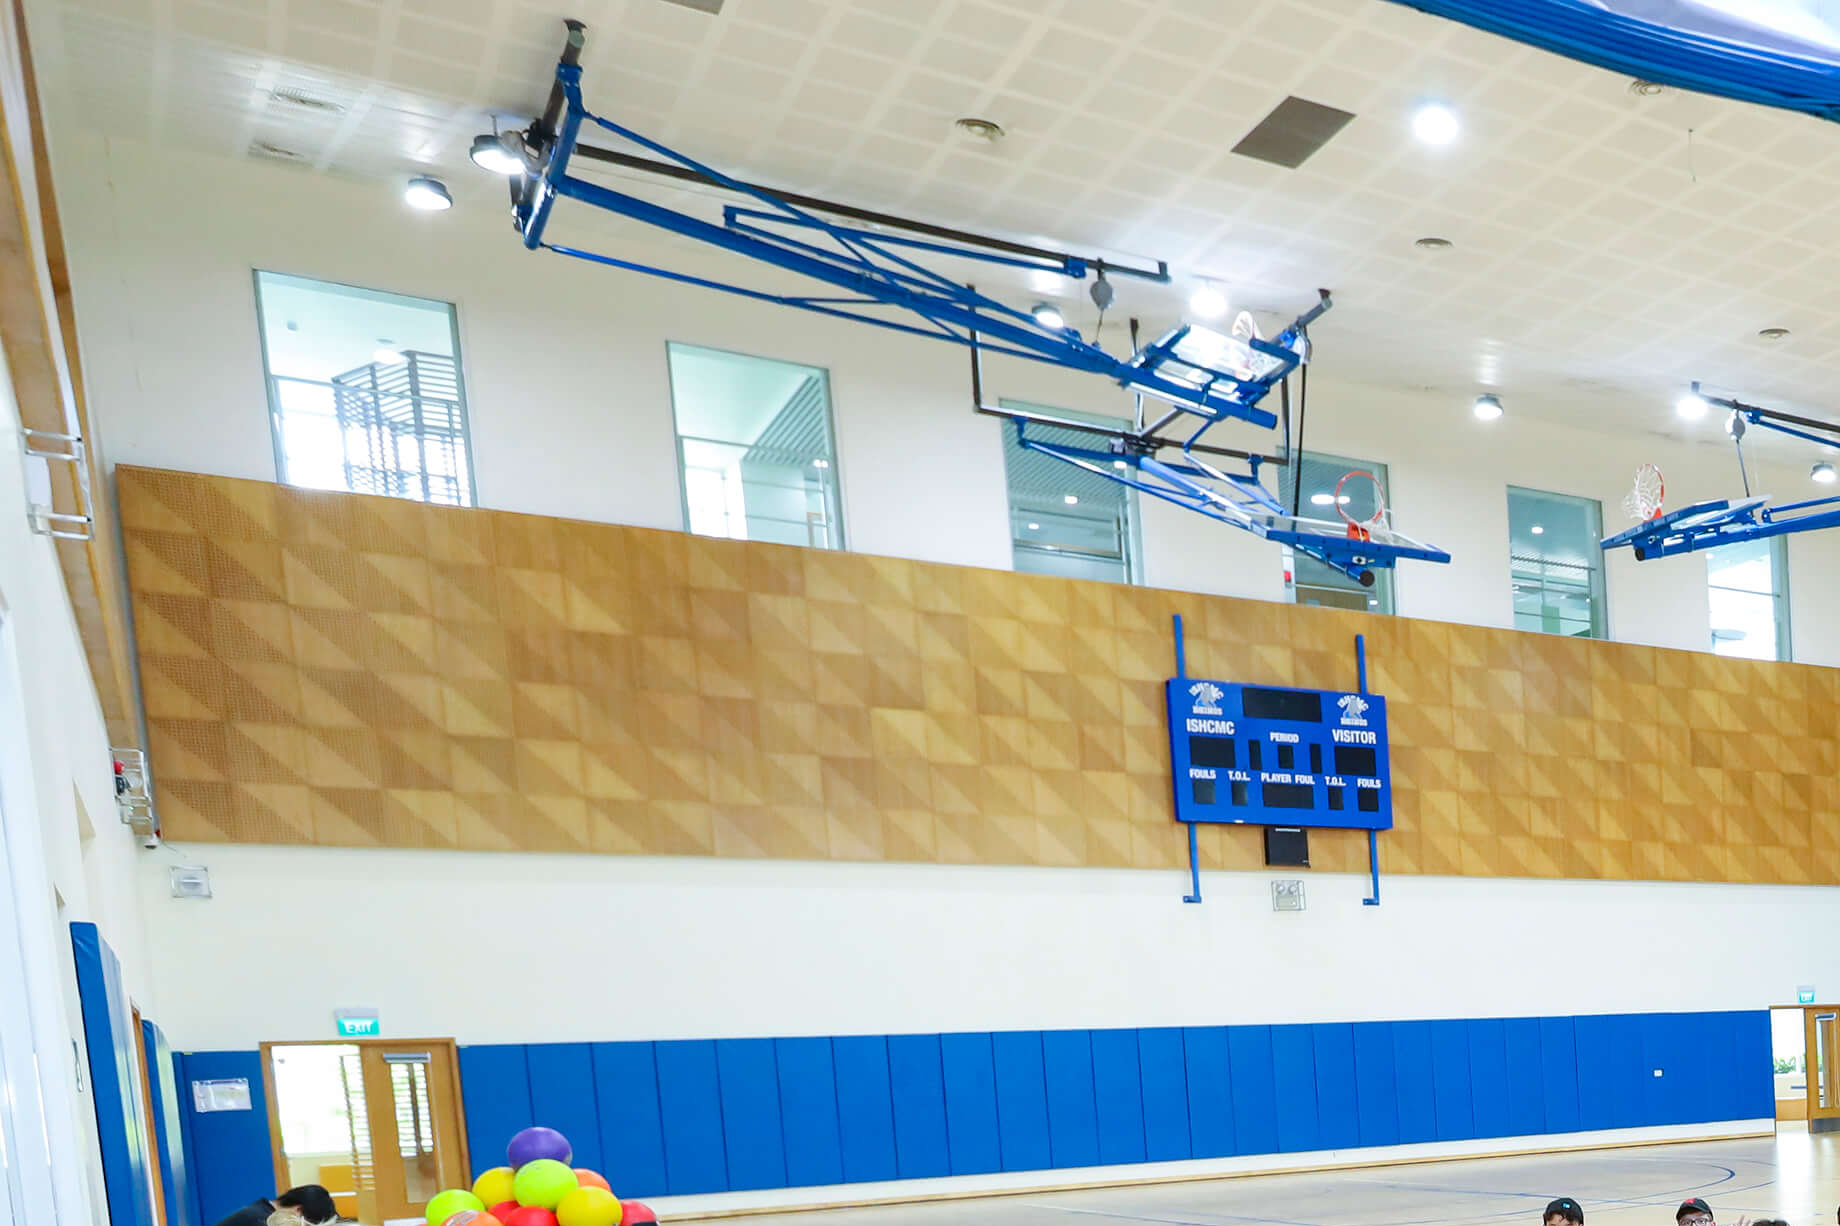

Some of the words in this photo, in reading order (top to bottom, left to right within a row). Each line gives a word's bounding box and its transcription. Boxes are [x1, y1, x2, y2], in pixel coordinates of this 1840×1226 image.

[1186, 718, 1236, 735] ISHCMC
[1270, 731, 1299, 743] PERIOD
[1332, 728, 1377, 744] VISITOR
[1189, 768, 1217, 779] FOULS
[1261, 772, 1292, 784] PLAYER
[1295, 774, 1315, 785] FOUL
[1357, 778, 1381, 788] FOULS
[344, 1021, 372, 1034] EXIT
